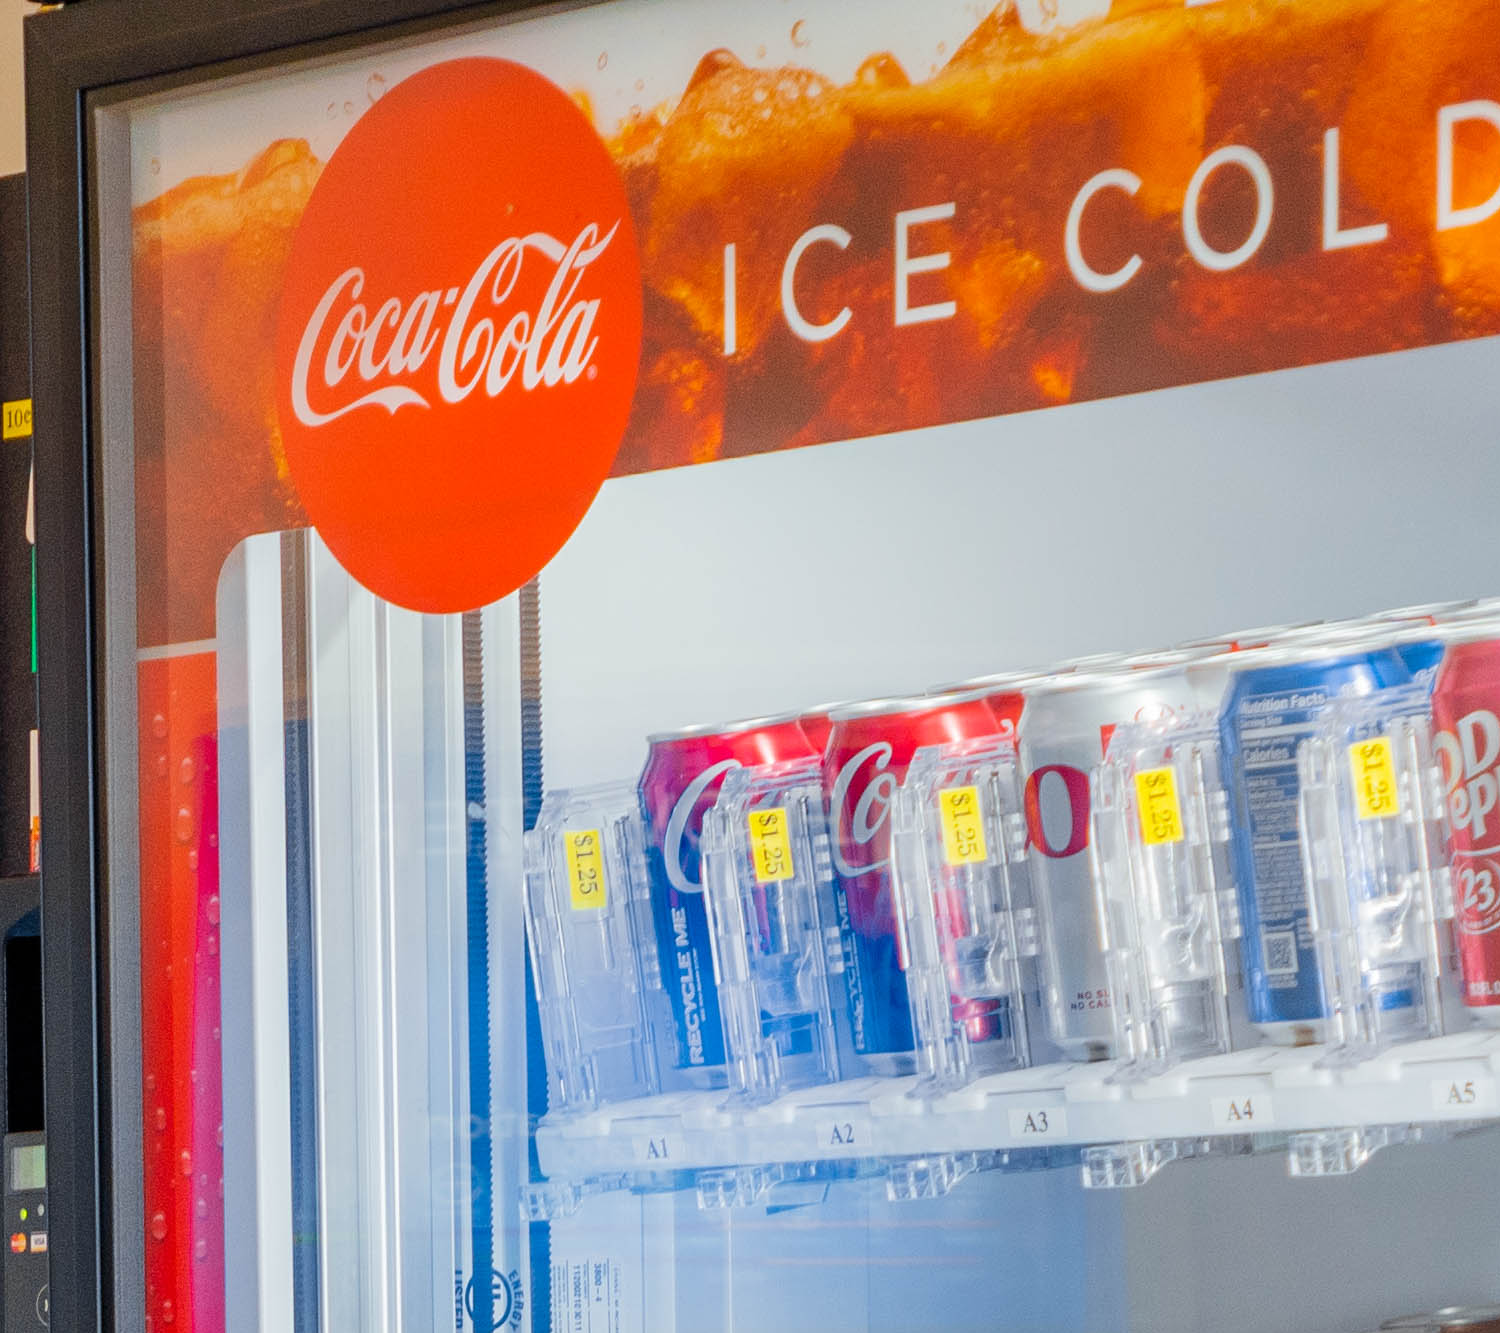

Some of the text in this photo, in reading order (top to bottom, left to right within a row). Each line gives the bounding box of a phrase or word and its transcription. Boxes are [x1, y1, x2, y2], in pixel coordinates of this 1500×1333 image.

[721, 202, 961, 358] ICE
[290, 216, 621, 429] Coca-Cola
[1145, 773, 1178, 841] $1.25
[1360, 742, 1391, 811] $1.25
[758, 812, 785, 877] $1.25
[951, 794, 979, 858] $1.25
[573, 834, 598, 897] $1.25
[1461, 866, 1496, 909] 23
[670, 907, 705, 1063] RECYCLE ME
[1023, 1111, 1050, 1134] A3
[1226, 1098, 1254, 1121] A4
[1446, 1081, 1476, 1104] A5
[647, 1137, 669, 1160] A1
[830, 1122, 854, 1145] A2
